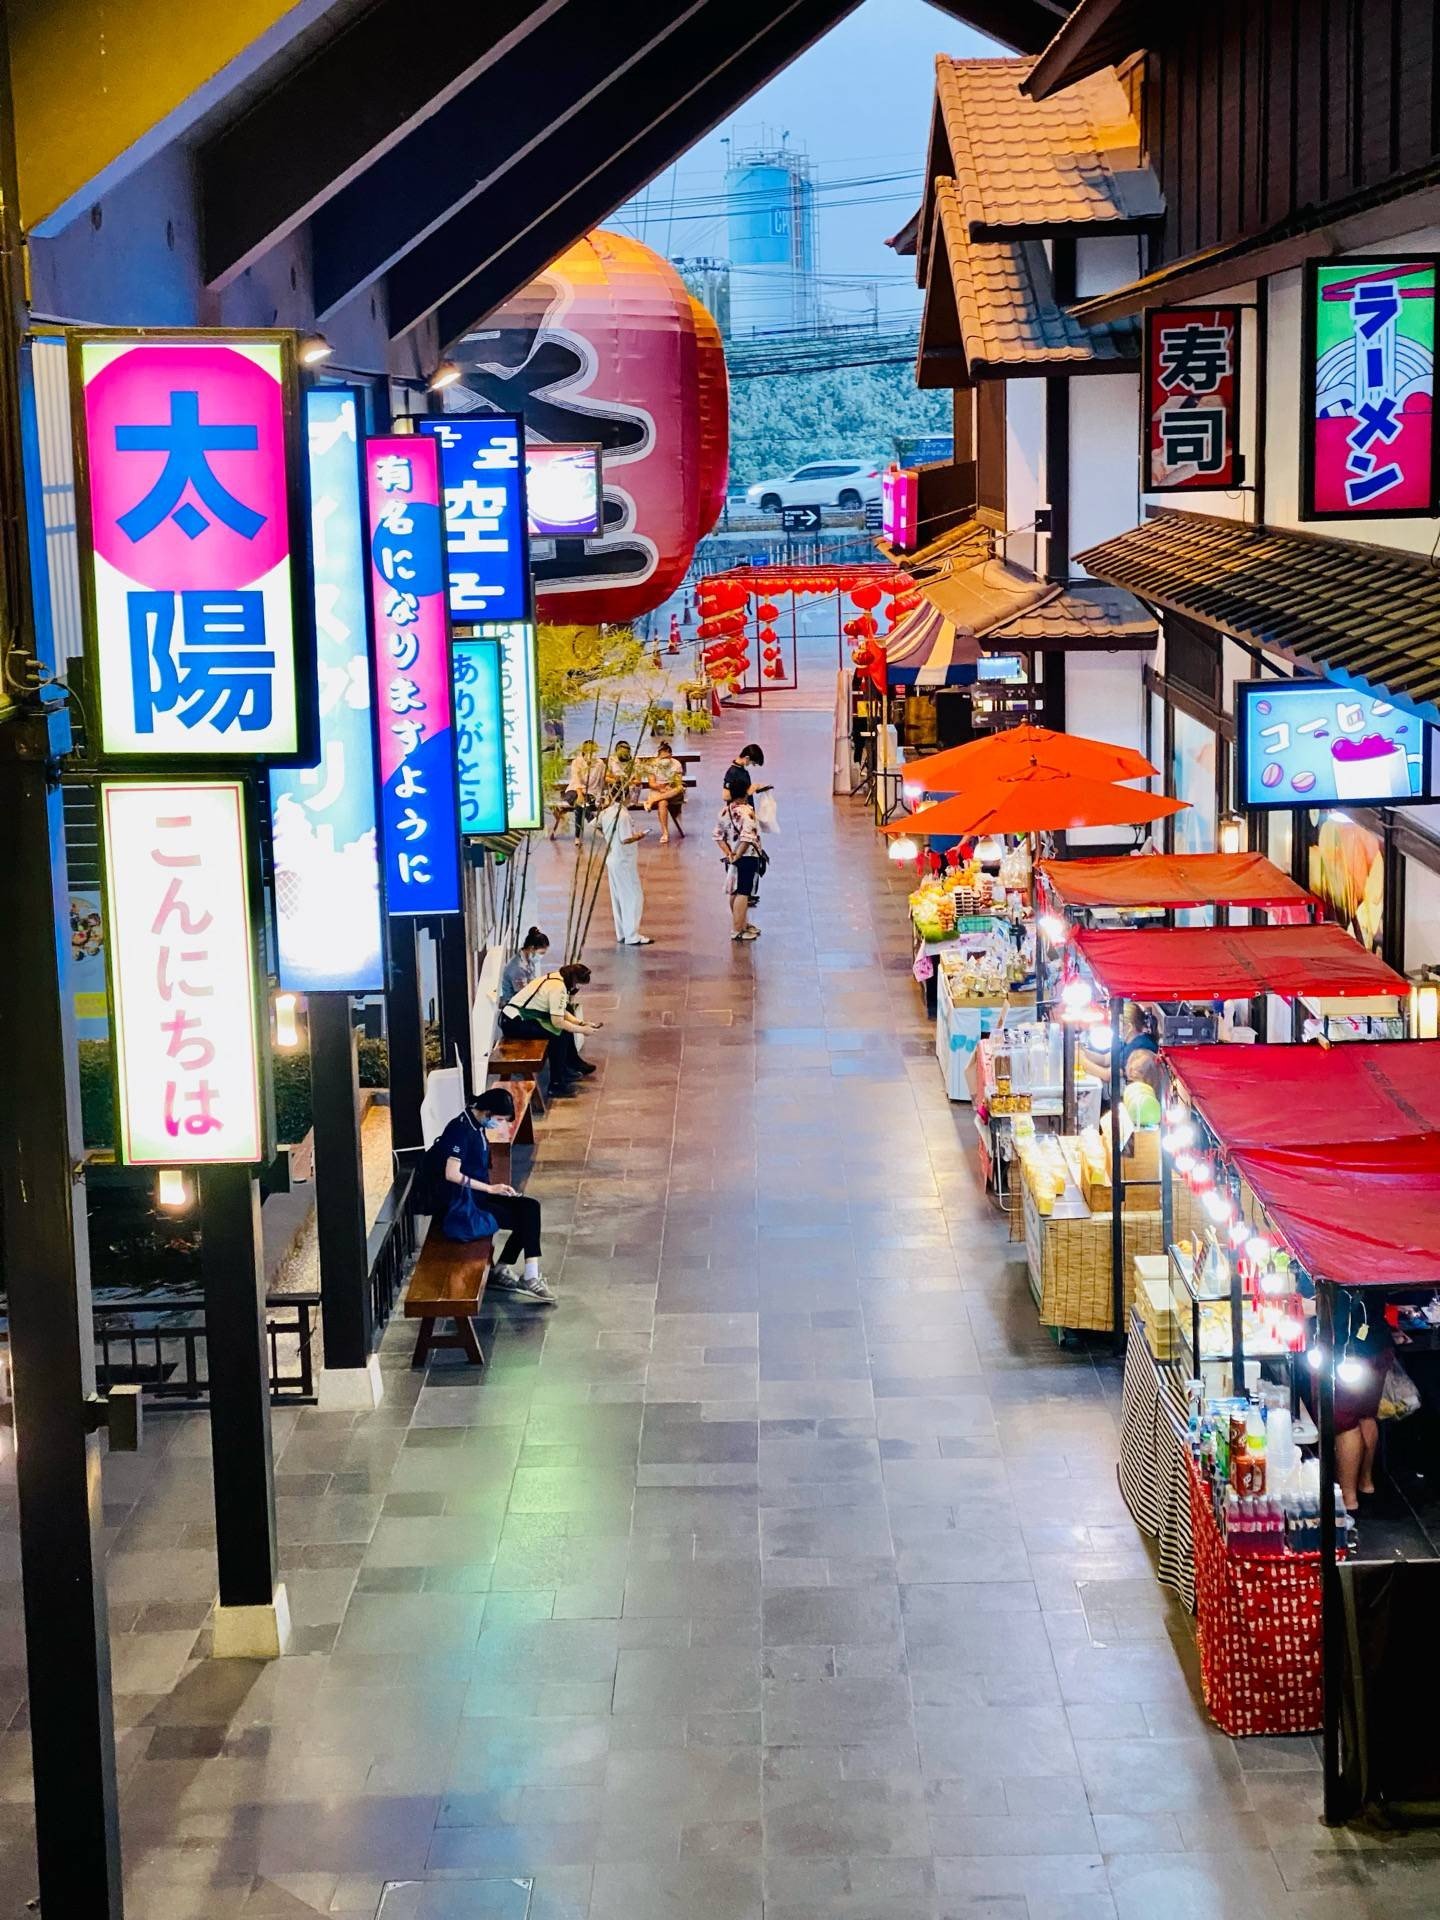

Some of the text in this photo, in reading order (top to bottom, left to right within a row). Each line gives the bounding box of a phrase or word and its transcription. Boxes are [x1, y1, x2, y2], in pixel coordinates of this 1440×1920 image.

[1159, 325, 1228, 472] 寿司
[1347, 283, 1402, 504] ラーメン
[114, 391, 275, 734] 太陽
[444, 480, 509, 552] 空
[375, 455, 432, 885] 有名になりますように
[453, 653, 485, 821] ありがとう
[151, 816, 224, 1137] こんにちは
